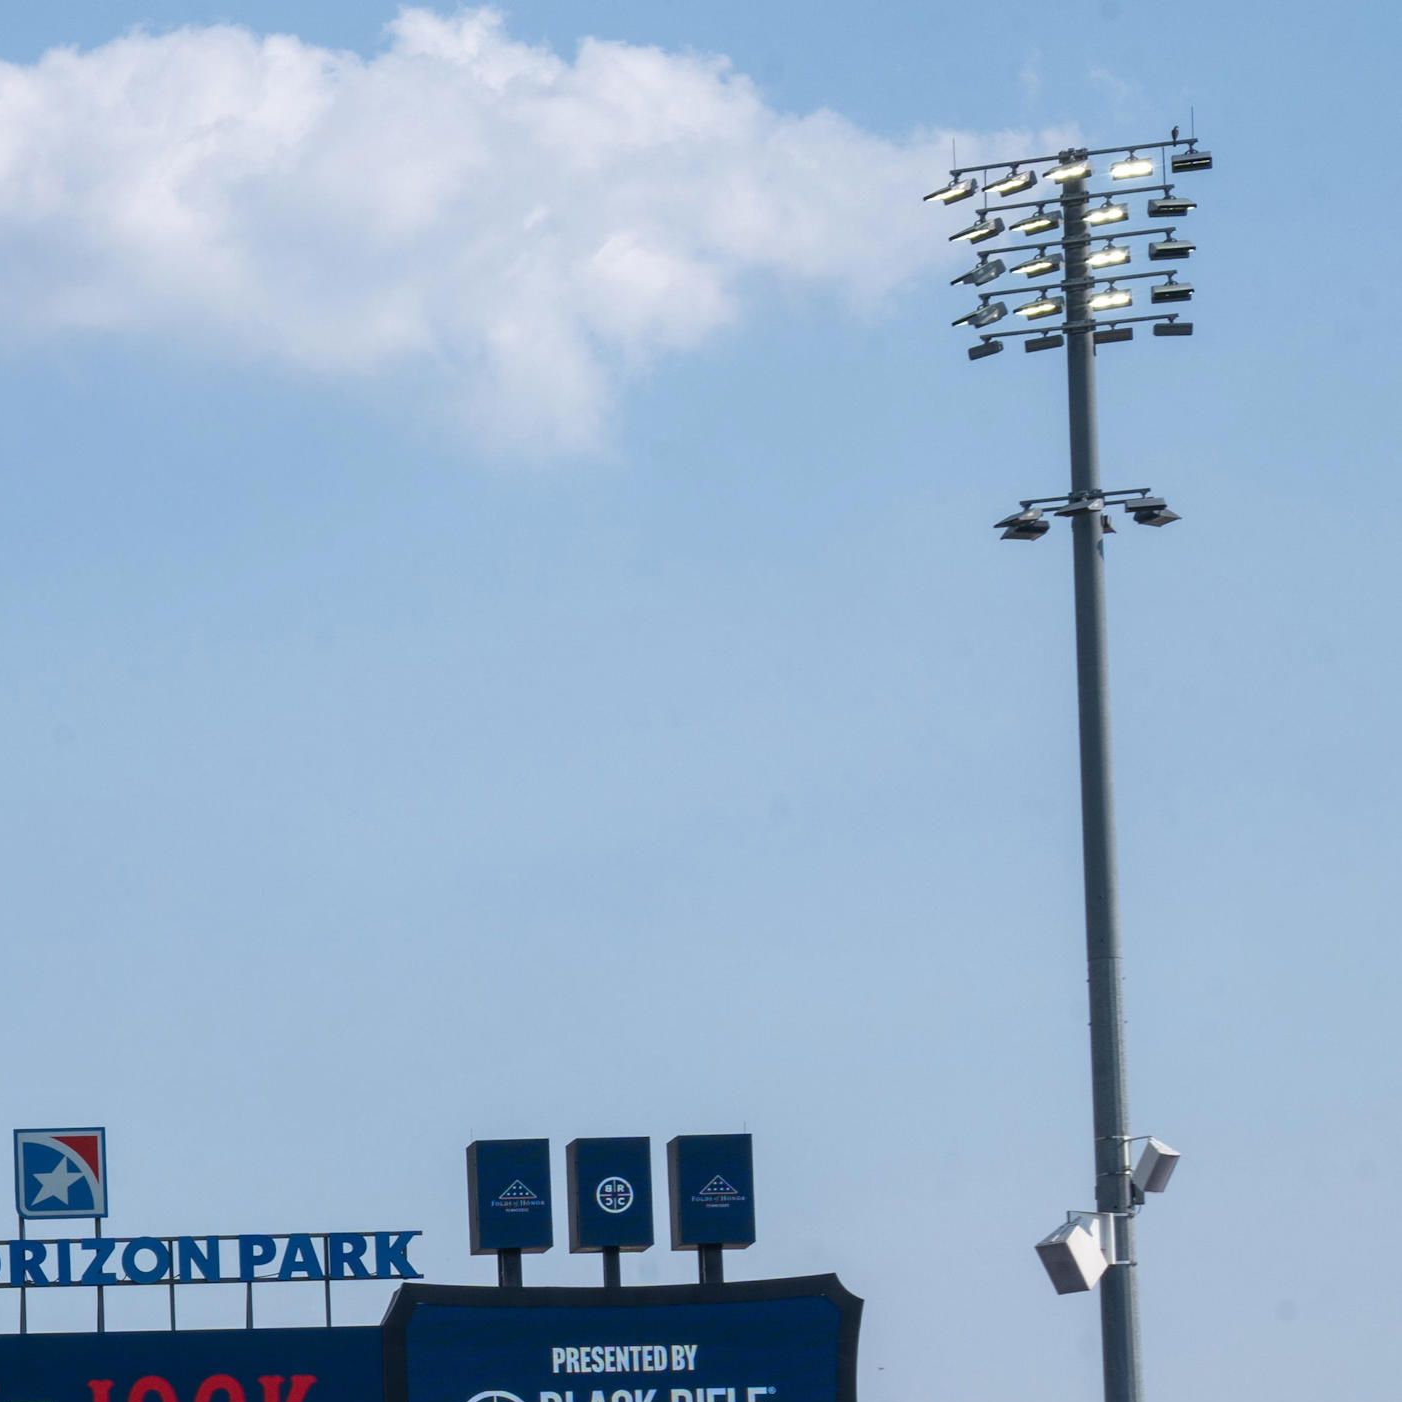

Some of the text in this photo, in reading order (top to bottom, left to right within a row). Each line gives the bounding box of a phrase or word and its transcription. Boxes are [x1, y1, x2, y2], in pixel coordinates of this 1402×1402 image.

[238, 1232, 420, 1282] PARK
[552, 1344, 698, 1373] PRESENTED BY
